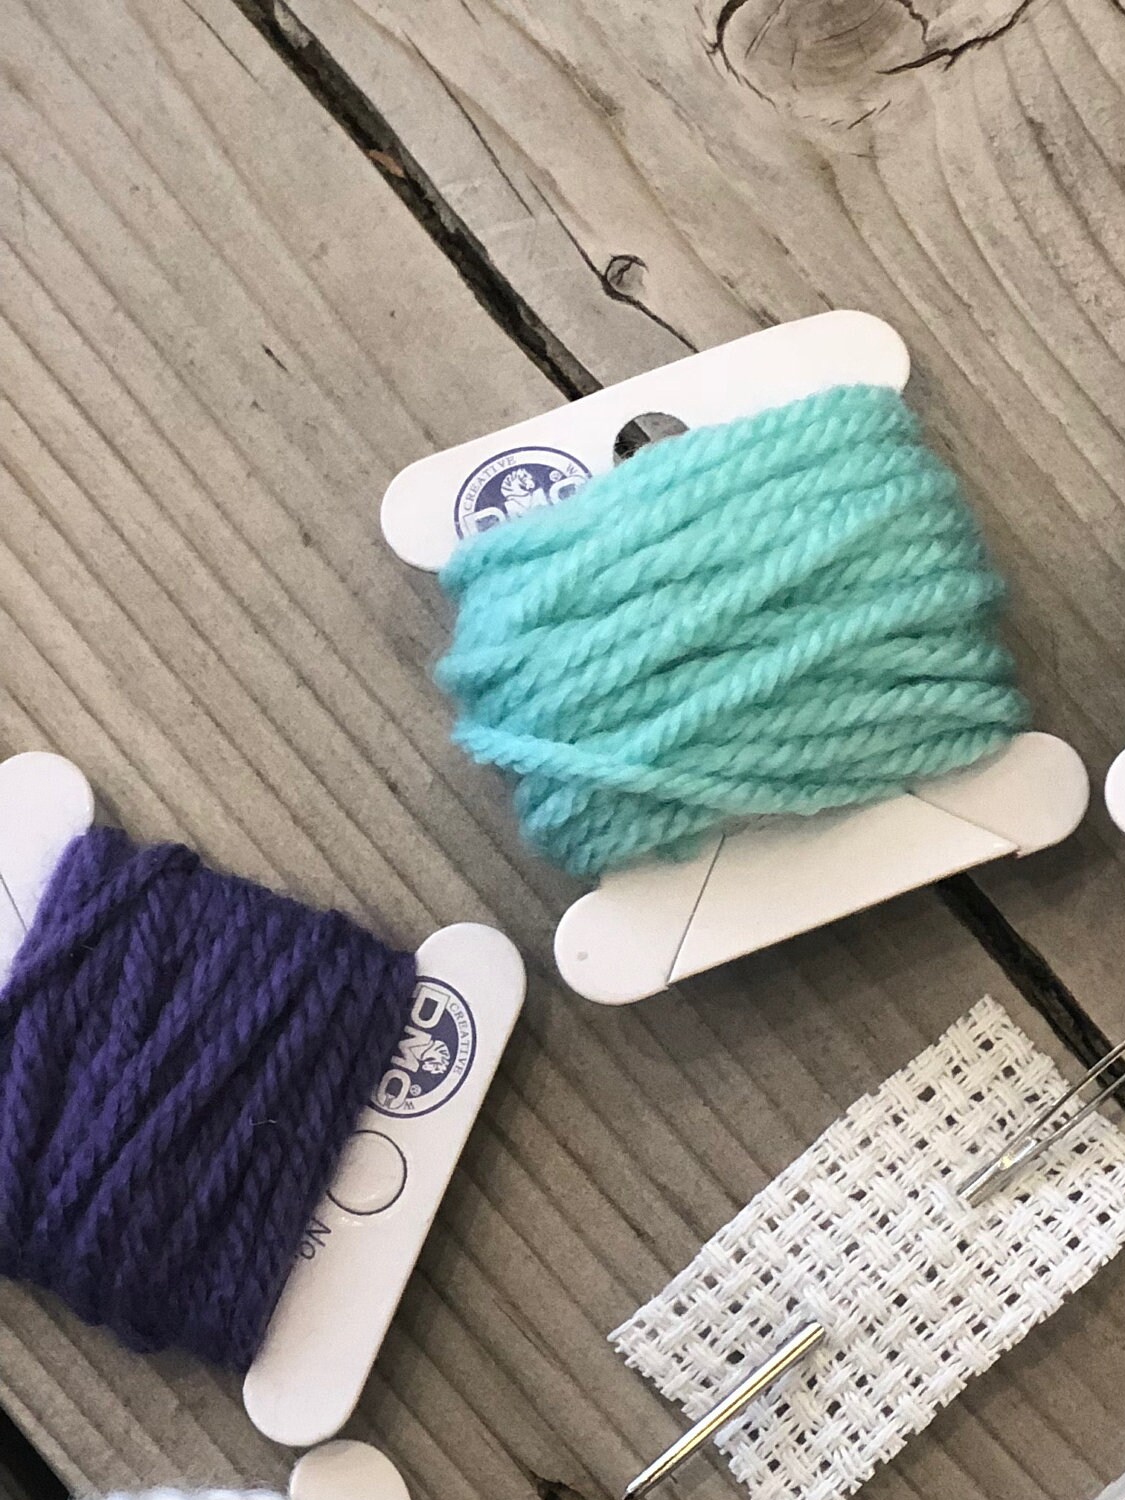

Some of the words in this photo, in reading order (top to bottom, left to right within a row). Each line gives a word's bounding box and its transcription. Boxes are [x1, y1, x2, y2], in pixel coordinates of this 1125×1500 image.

[463, 456, 517, 511] CREATIVE
[376, 984, 451, 1110] DMC
[449, 1002, 470, 1075] CREATIVE
